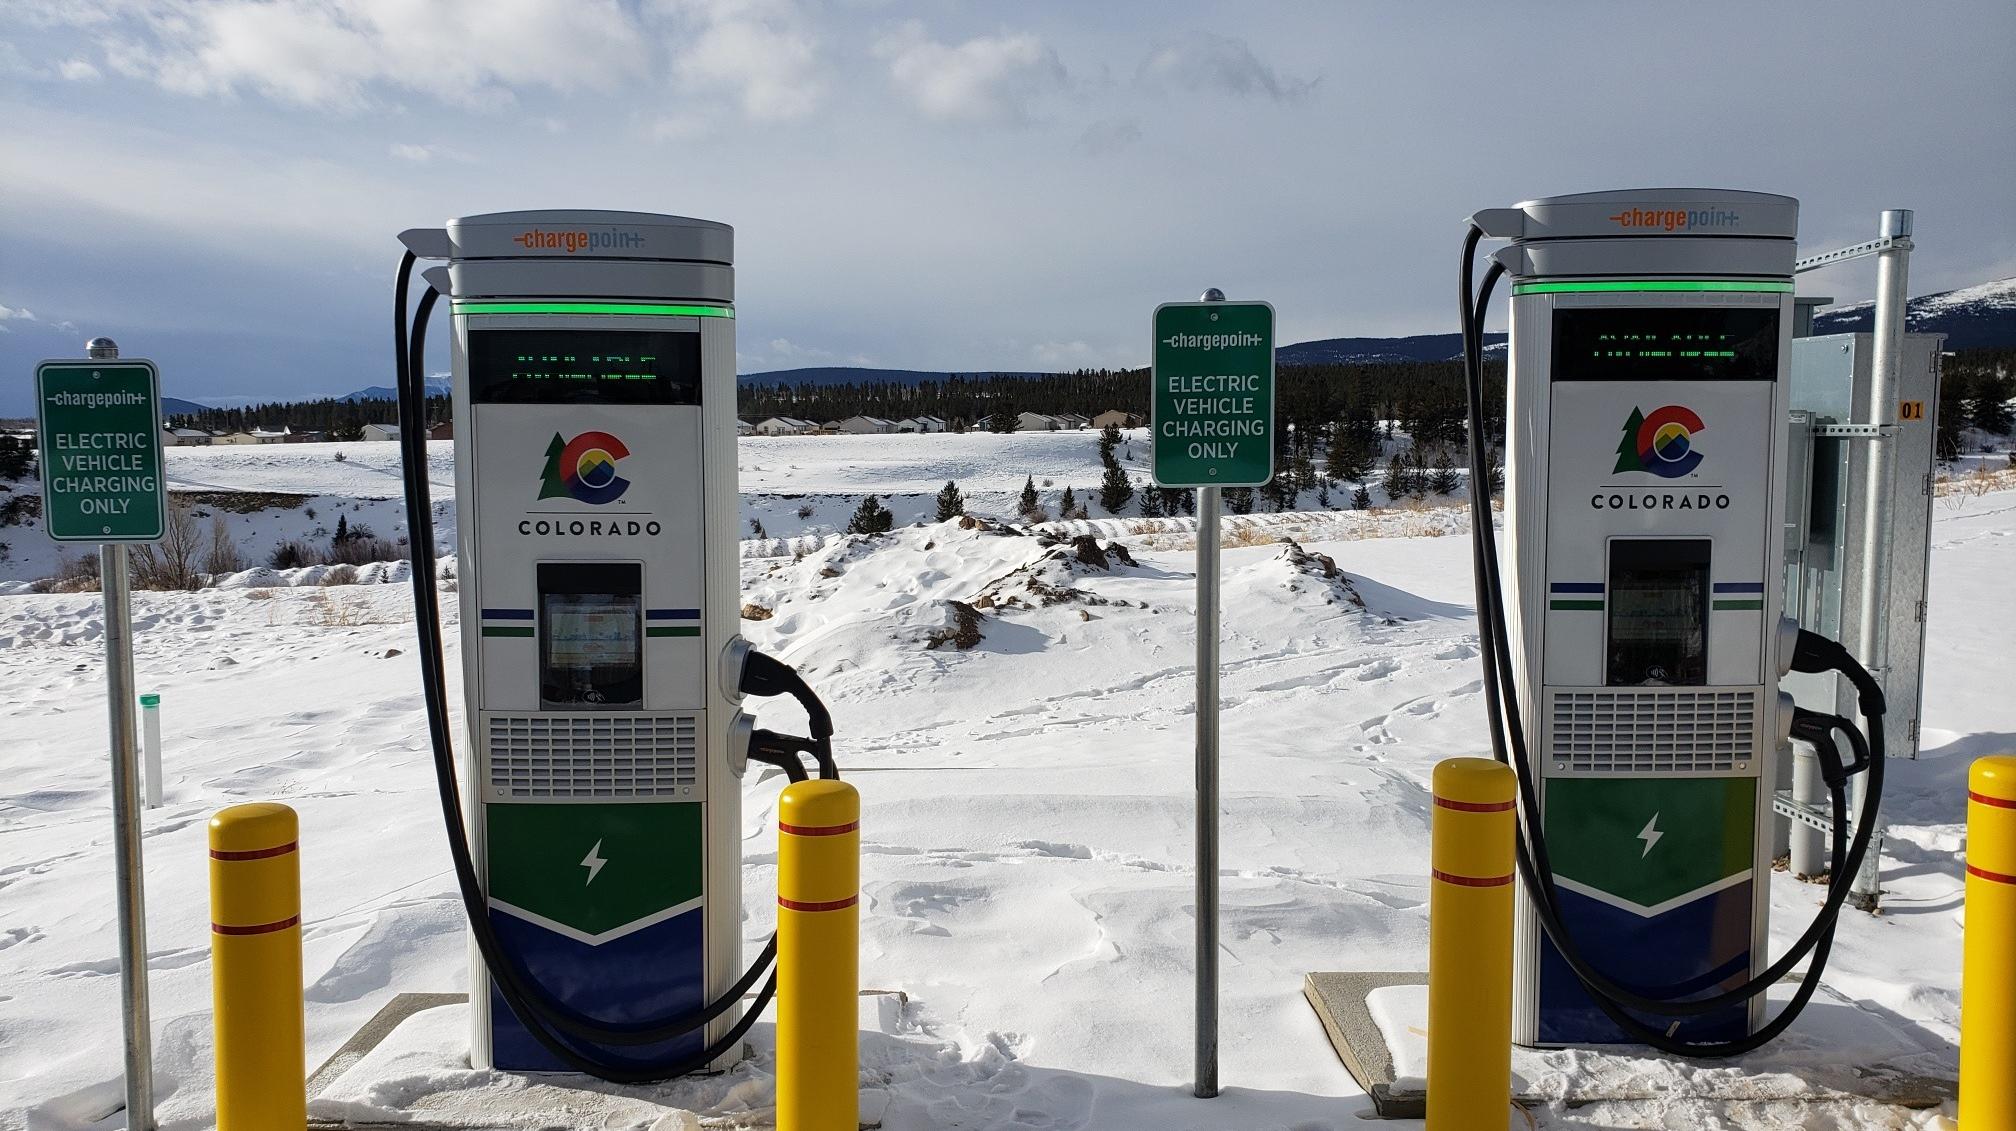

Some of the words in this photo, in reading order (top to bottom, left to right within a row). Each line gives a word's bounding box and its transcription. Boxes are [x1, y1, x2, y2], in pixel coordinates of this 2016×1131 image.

[1168, 375, 1260, 393] ELECTRIC
[1173, 397, 1254, 415] VEHICLE
[1902, 402, 1921, 419] 01
[1162, 419, 1265, 437] CHARGING
[55, 433, 147, 450] ELECTRIC
[1188, 442, 1239, 459] ONLY
[62, 454, 144, 471] VEHICLE
[53, 476, 155, 493] CHARGING
[80, 498, 131, 515] ONLY
[1591, 494, 1730, 510] COLORADO
[518, 520, 661, 536] COLORADO
